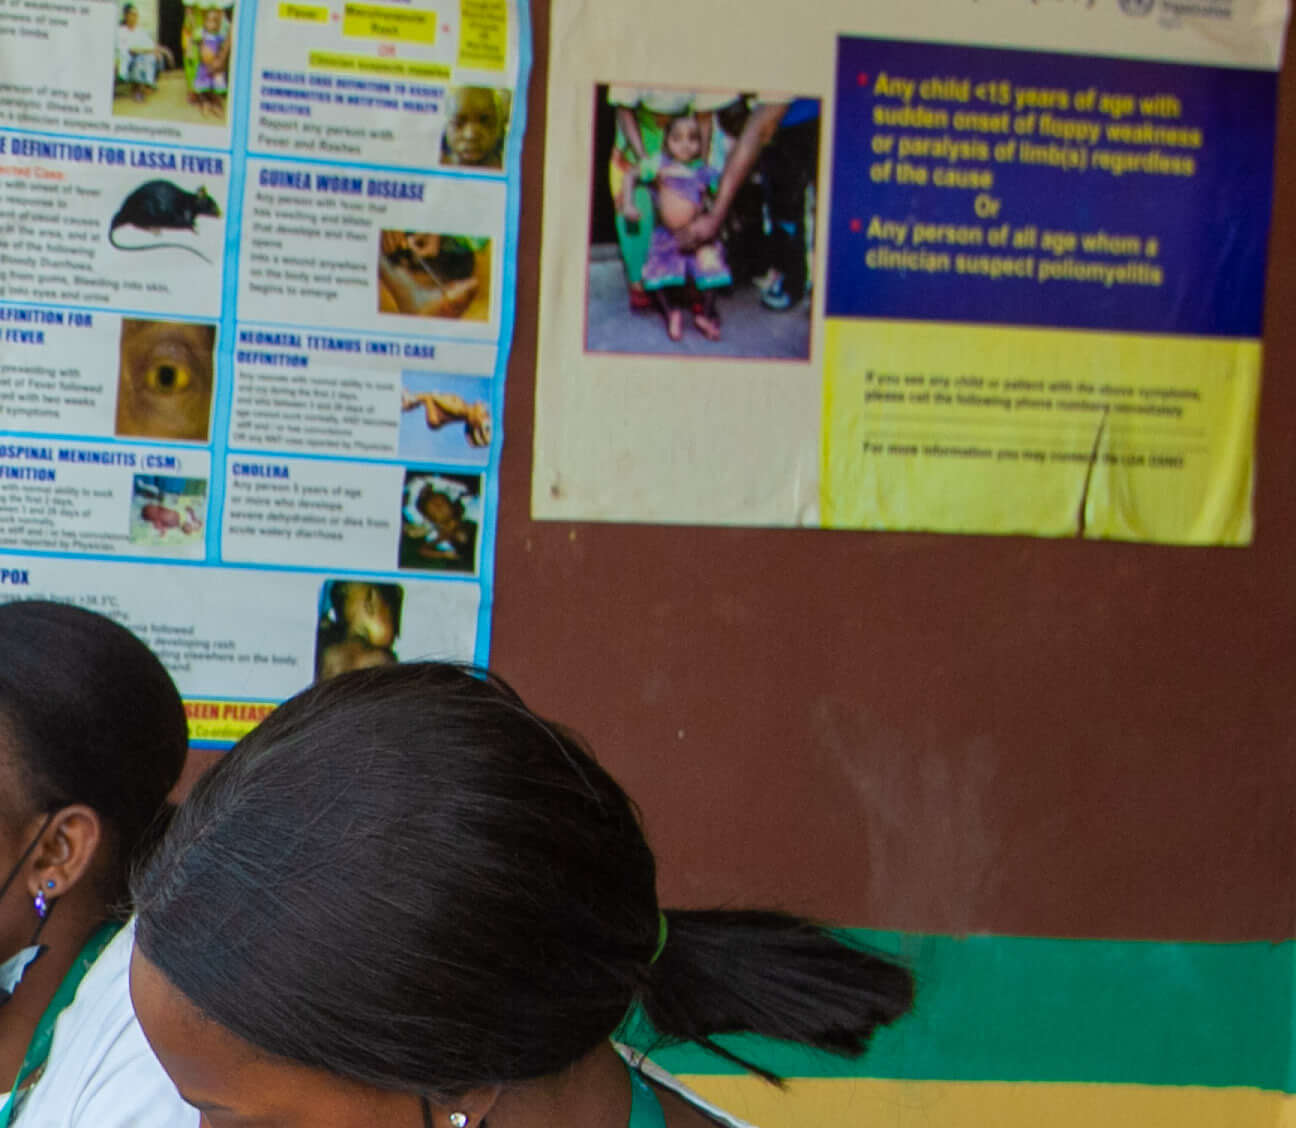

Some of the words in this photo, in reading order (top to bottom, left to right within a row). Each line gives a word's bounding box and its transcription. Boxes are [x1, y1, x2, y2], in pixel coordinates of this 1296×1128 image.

[873, 72, 915, 104] Any
[919, 78, 970, 103] child
[975, 81, 1011, 105] <15
[1015, 88, 1069, 112] years
[1074, 87, 1098, 111] of
[1099, 92, 1135, 119] age
[1139, 93, 1181, 118] with
[873, 105, 948, 128] sudden
[953, 110, 1010, 133] onset
[1014, 111, 1037, 135] of
[1038, 114, 1101, 142] floppy
[1106, 119, 1203, 148] weakness
[11, 138, 93, 163] DEFINITION
[98, 146, 126, 166] FOR
[130, 149, 176, 171] LASSA
[181, 154, 224, 176] FEVER
[872, 136, 894, 154] or
[898, 135, 990, 163] paralysis
[994, 139, 1017, 162] of
[1019, 142, 1088, 171] limb(s)
[1092, 149, 1195, 176] regardless
[259, 169, 312, 190] GUINEA
[316, 174, 362, 195] WORM
[367, 178, 425, 202] DISEASE
[870, 159, 893, 182] of
[896, 162, 928, 185] the
[932, 168, 994, 189] cause
[974, 194, 1001, 219] Or
[867, 215, 908, 246] Any
[912, 221, 983, 247] person
[987, 223, 1010, 246] of
[1012, 226, 1037, 249] all
[1041, 232, 1077, 257] age
[1081, 231, 1141, 254] whom
[1144, 239, 1158, 258] a
[865, 248, 951, 273] clinician
[955, 253, 1035, 281] suspect
[1038, 257, 1163, 288] poliomyelitis
[68, 312, 93, 328] FOR
[5, 328, 45, 345] FEVER
[239, 331, 302, 349] NEONATAL
[307, 336, 361, 354] TETANUS
[404, 344, 436, 359] CASE
[237, 350, 309, 368] DEFINITION
[58, 447, 136, 467] MENINGITIS
[140, 453, 181, 472] (CSM)
[232, 463, 289, 479] CHOLERA
[223, 703, 275, 722] PLEAS
